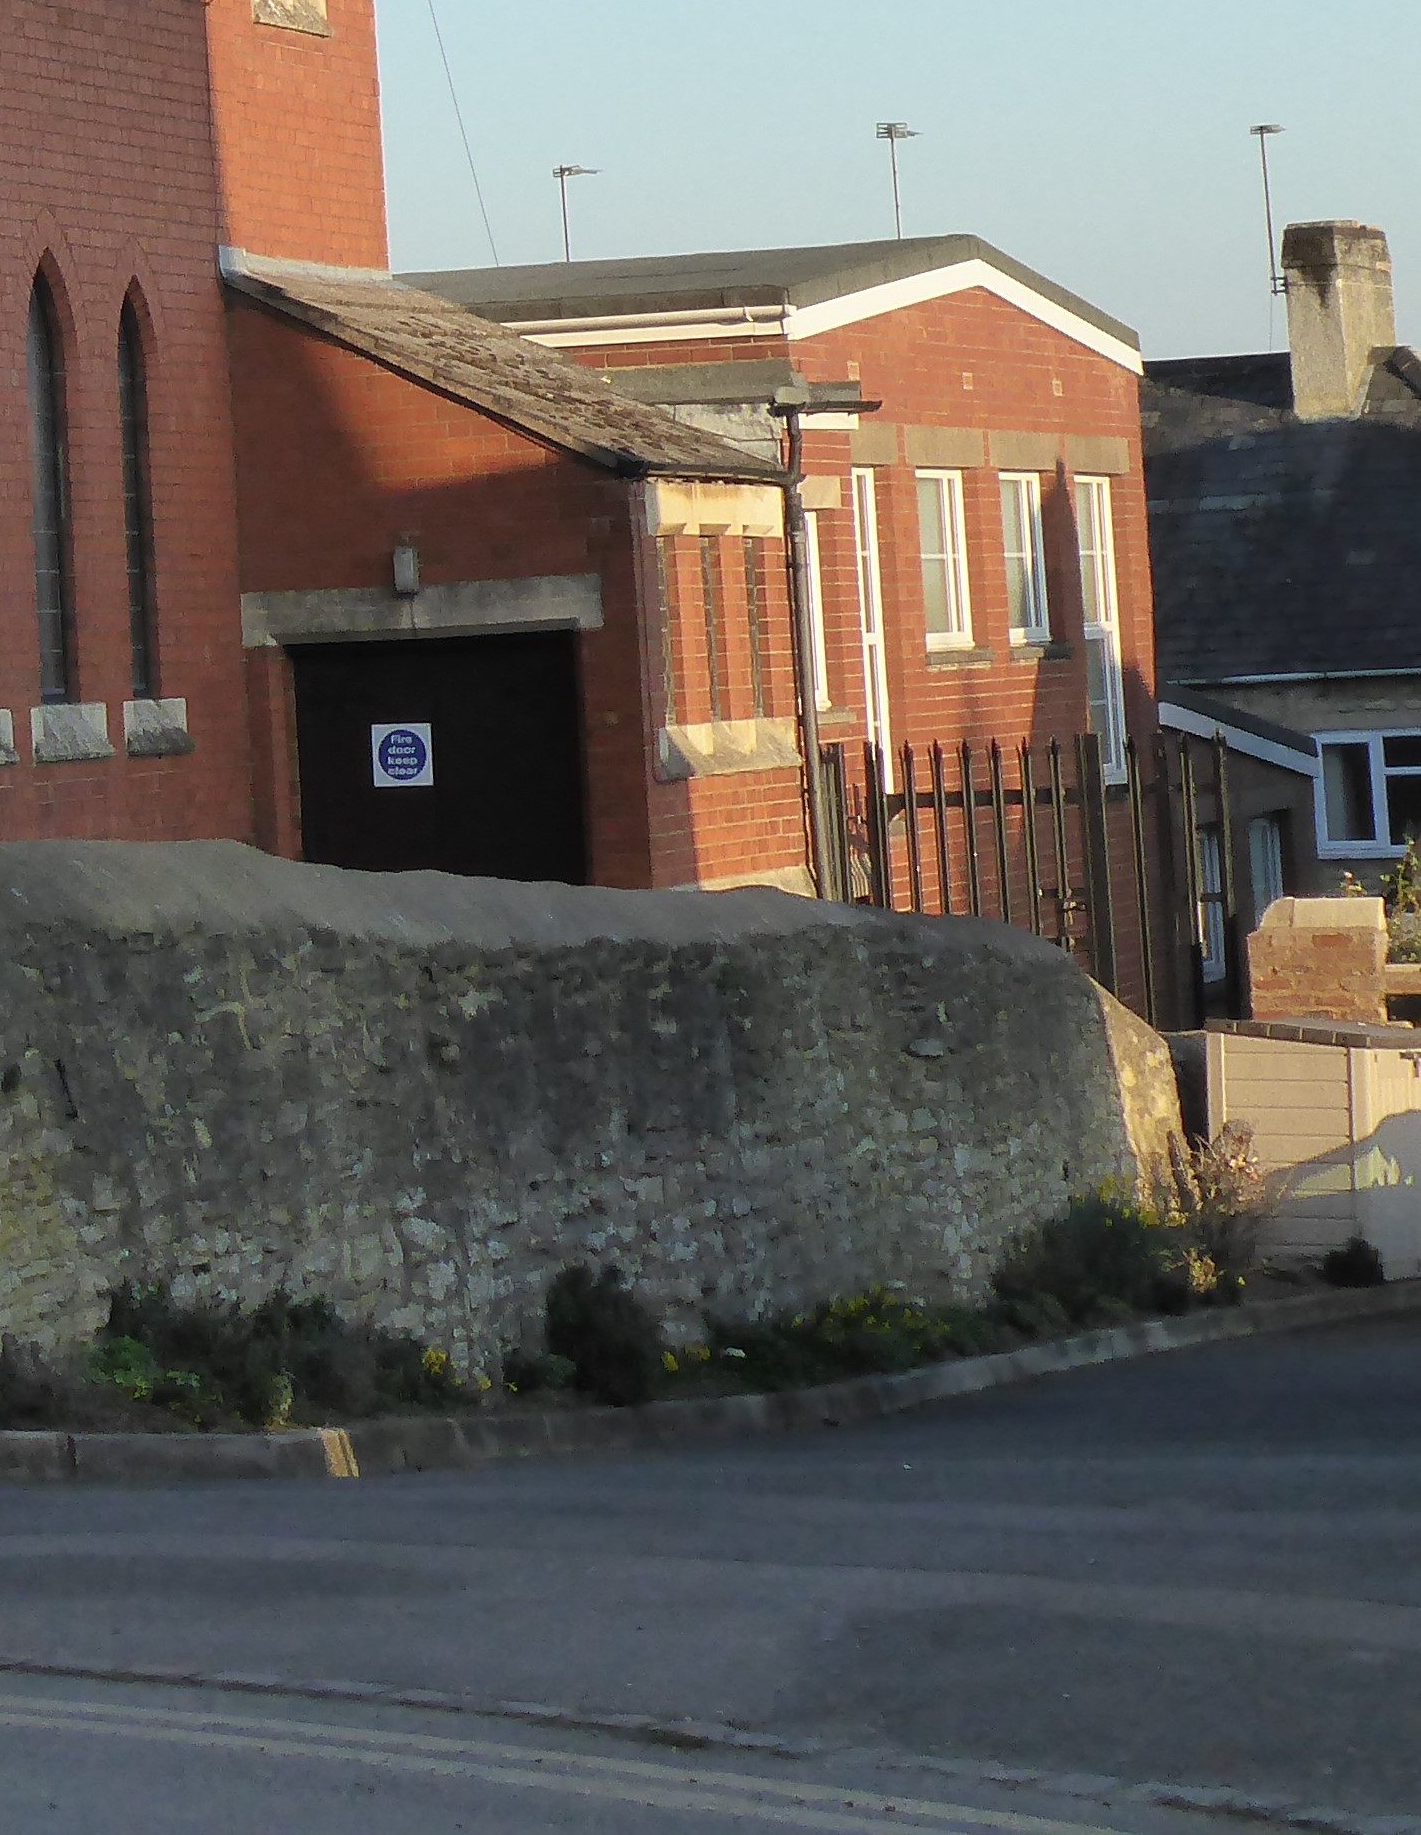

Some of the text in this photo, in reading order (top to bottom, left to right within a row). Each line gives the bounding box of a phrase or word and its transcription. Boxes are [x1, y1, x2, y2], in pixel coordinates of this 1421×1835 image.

[391, 735, 413, 743] Fire
[388, 746, 416, 754] door
[387, 756, 418, 765] keep
[388, 767, 418, 775] clear
